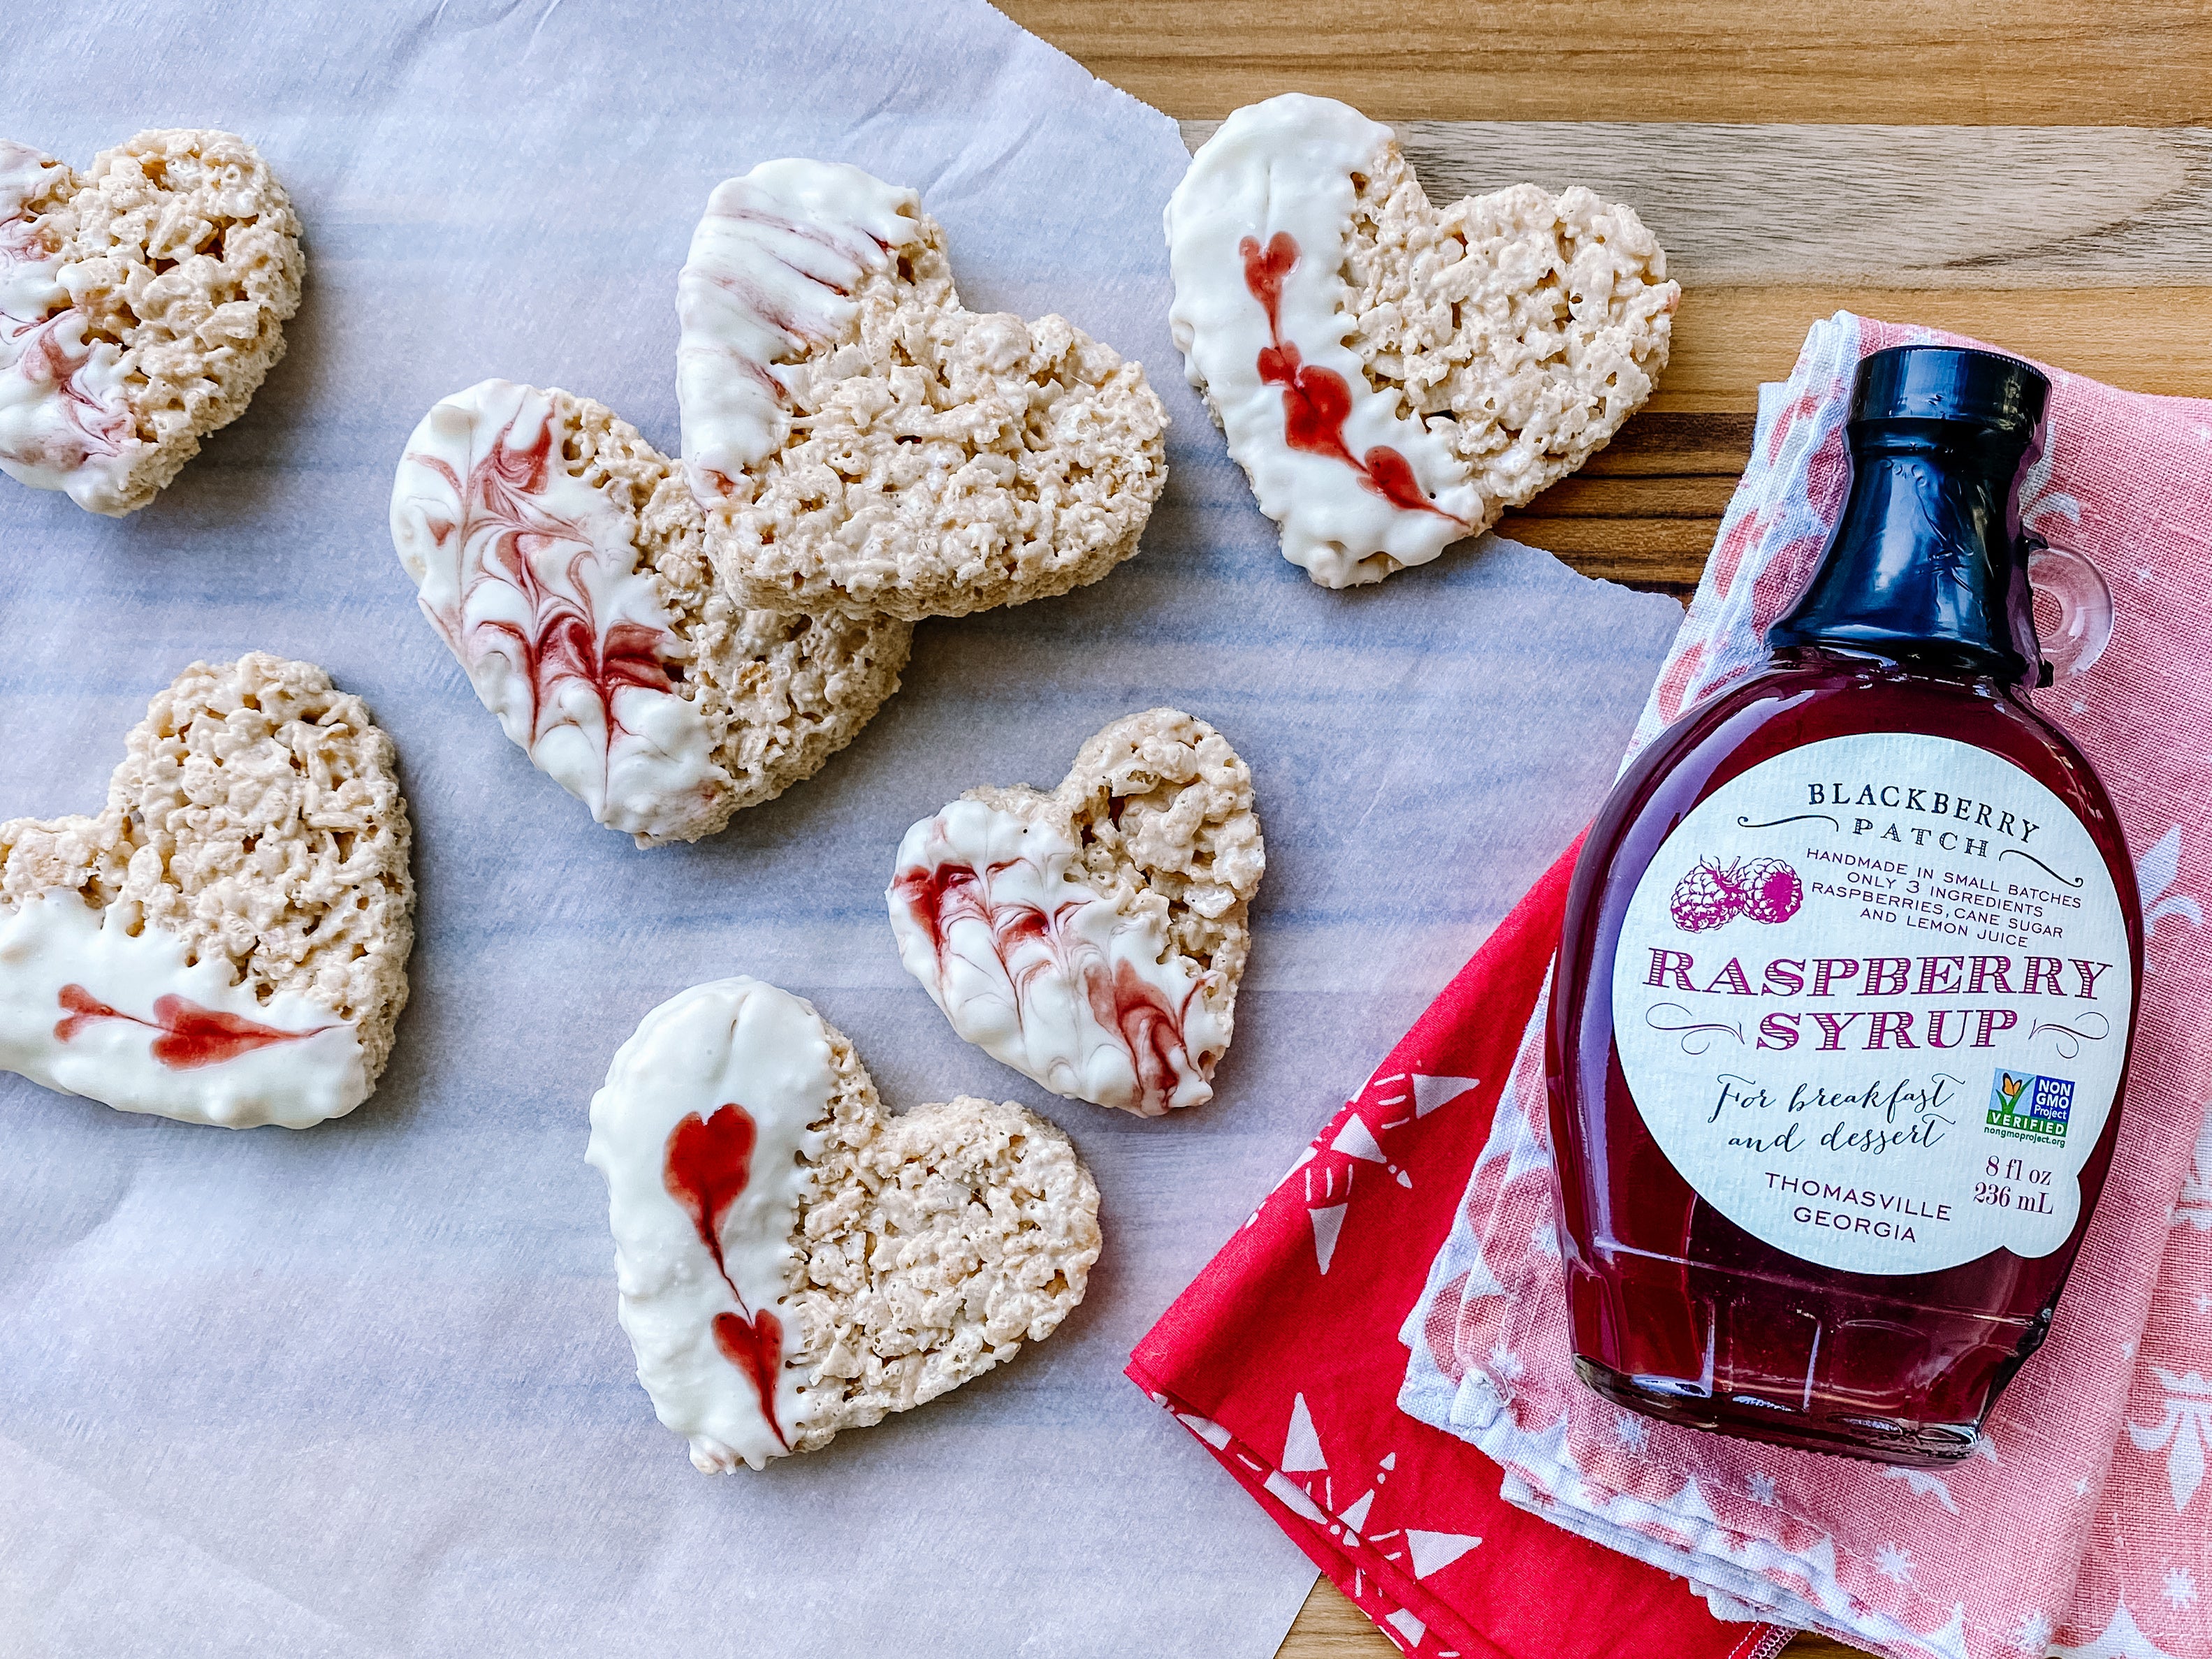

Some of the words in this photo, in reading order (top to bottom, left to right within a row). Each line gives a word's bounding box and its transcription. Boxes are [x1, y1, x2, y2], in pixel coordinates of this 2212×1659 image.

[1808, 782, 2039, 844] BLACKBERRY
[1852, 817, 1988, 858] PATCH
[1806, 849, 1907, 876] HANDMADE
[1917, 867, 1934, 880] IN
[1943, 870, 1999, 893] SMALL
[2008, 884, 2081, 908] BATCHES
[1847, 872, 1895, 890] ONLY
[1907, 880, 1920, 893] 3
[1931, 884, 2044, 916] INGREDIENTS
[1860, 907, 1897, 923] AND
[1907, 915, 1969, 936] LEMON
[1977, 929, 2029, 947] JUICE
[1953, 907, 2001, 926] CANE
[2008, 919, 2062, 939] SUGAR
[1643, 947, 2113, 1000] RASPBERRY
[1756, 1009, 2018, 1051] SYRUP
[1708, 1073, 1776, 1123] For
[1789, 1072, 1965, 1120] breakfast
[2036, 1093, 2069, 1109] GMO
[2039, 1079, 2072, 1095] NON
[1992, 1112, 2065, 1135] VERIFIED
[2034, 1105, 2067, 1120] Project
[1729, 1121, 1805, 1152] and
[1821, 1114, 1956, 1153] dessert
[1984, 1126, 2066, 1148] nongmoproject.org
[1986, 1155, 1999, 1176] 8
[2004, 1158, 2023, 1181] fl
[2029, 1169, 2052, 1185] oz
[1765, 1172, 1952, 1221] THOMASVILLE
[1973, 1182, 2011, 1207] 236
[2016, 1192, 2053, 1214] mL
[1794, 1207, 1916, 1243] GEORGIA
